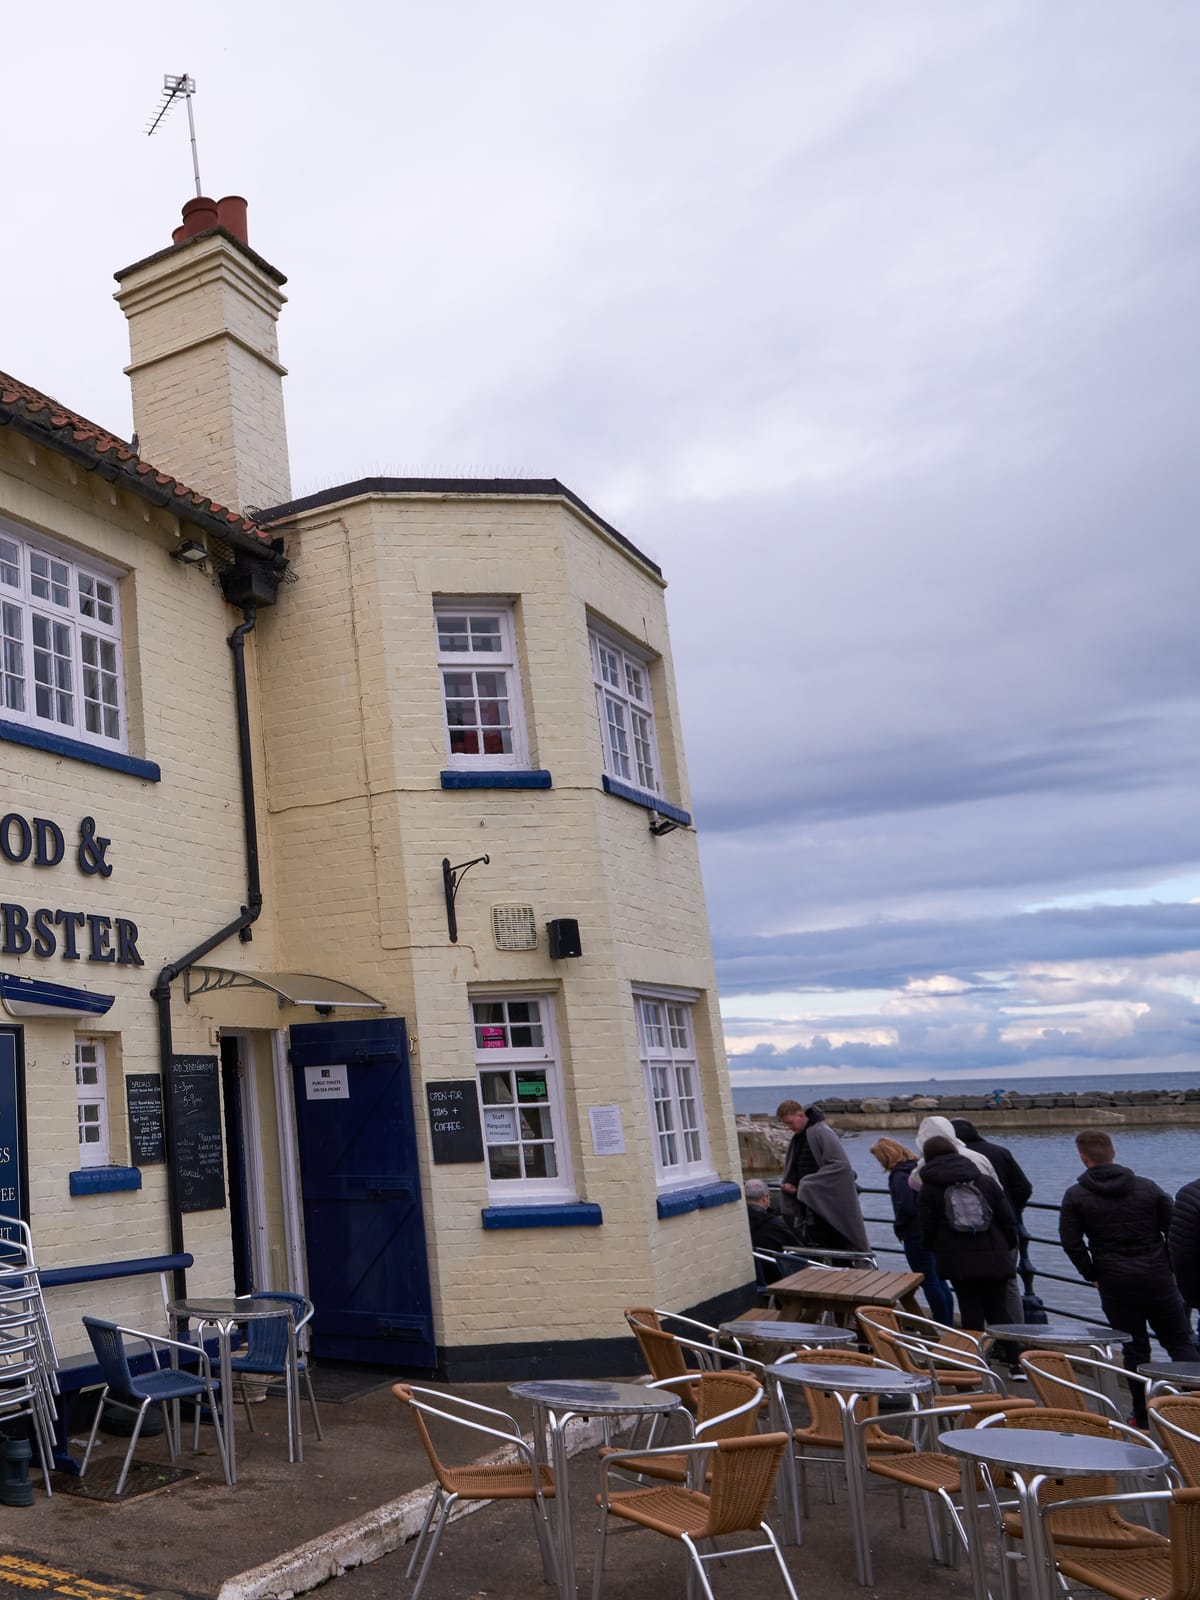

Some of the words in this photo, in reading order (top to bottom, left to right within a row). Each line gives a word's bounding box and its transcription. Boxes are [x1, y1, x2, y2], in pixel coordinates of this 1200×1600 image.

[78, 815, 113, 877] &
[491, 1112, 505, 1120] Staff
[486, 1122, 511, 1132] Required
